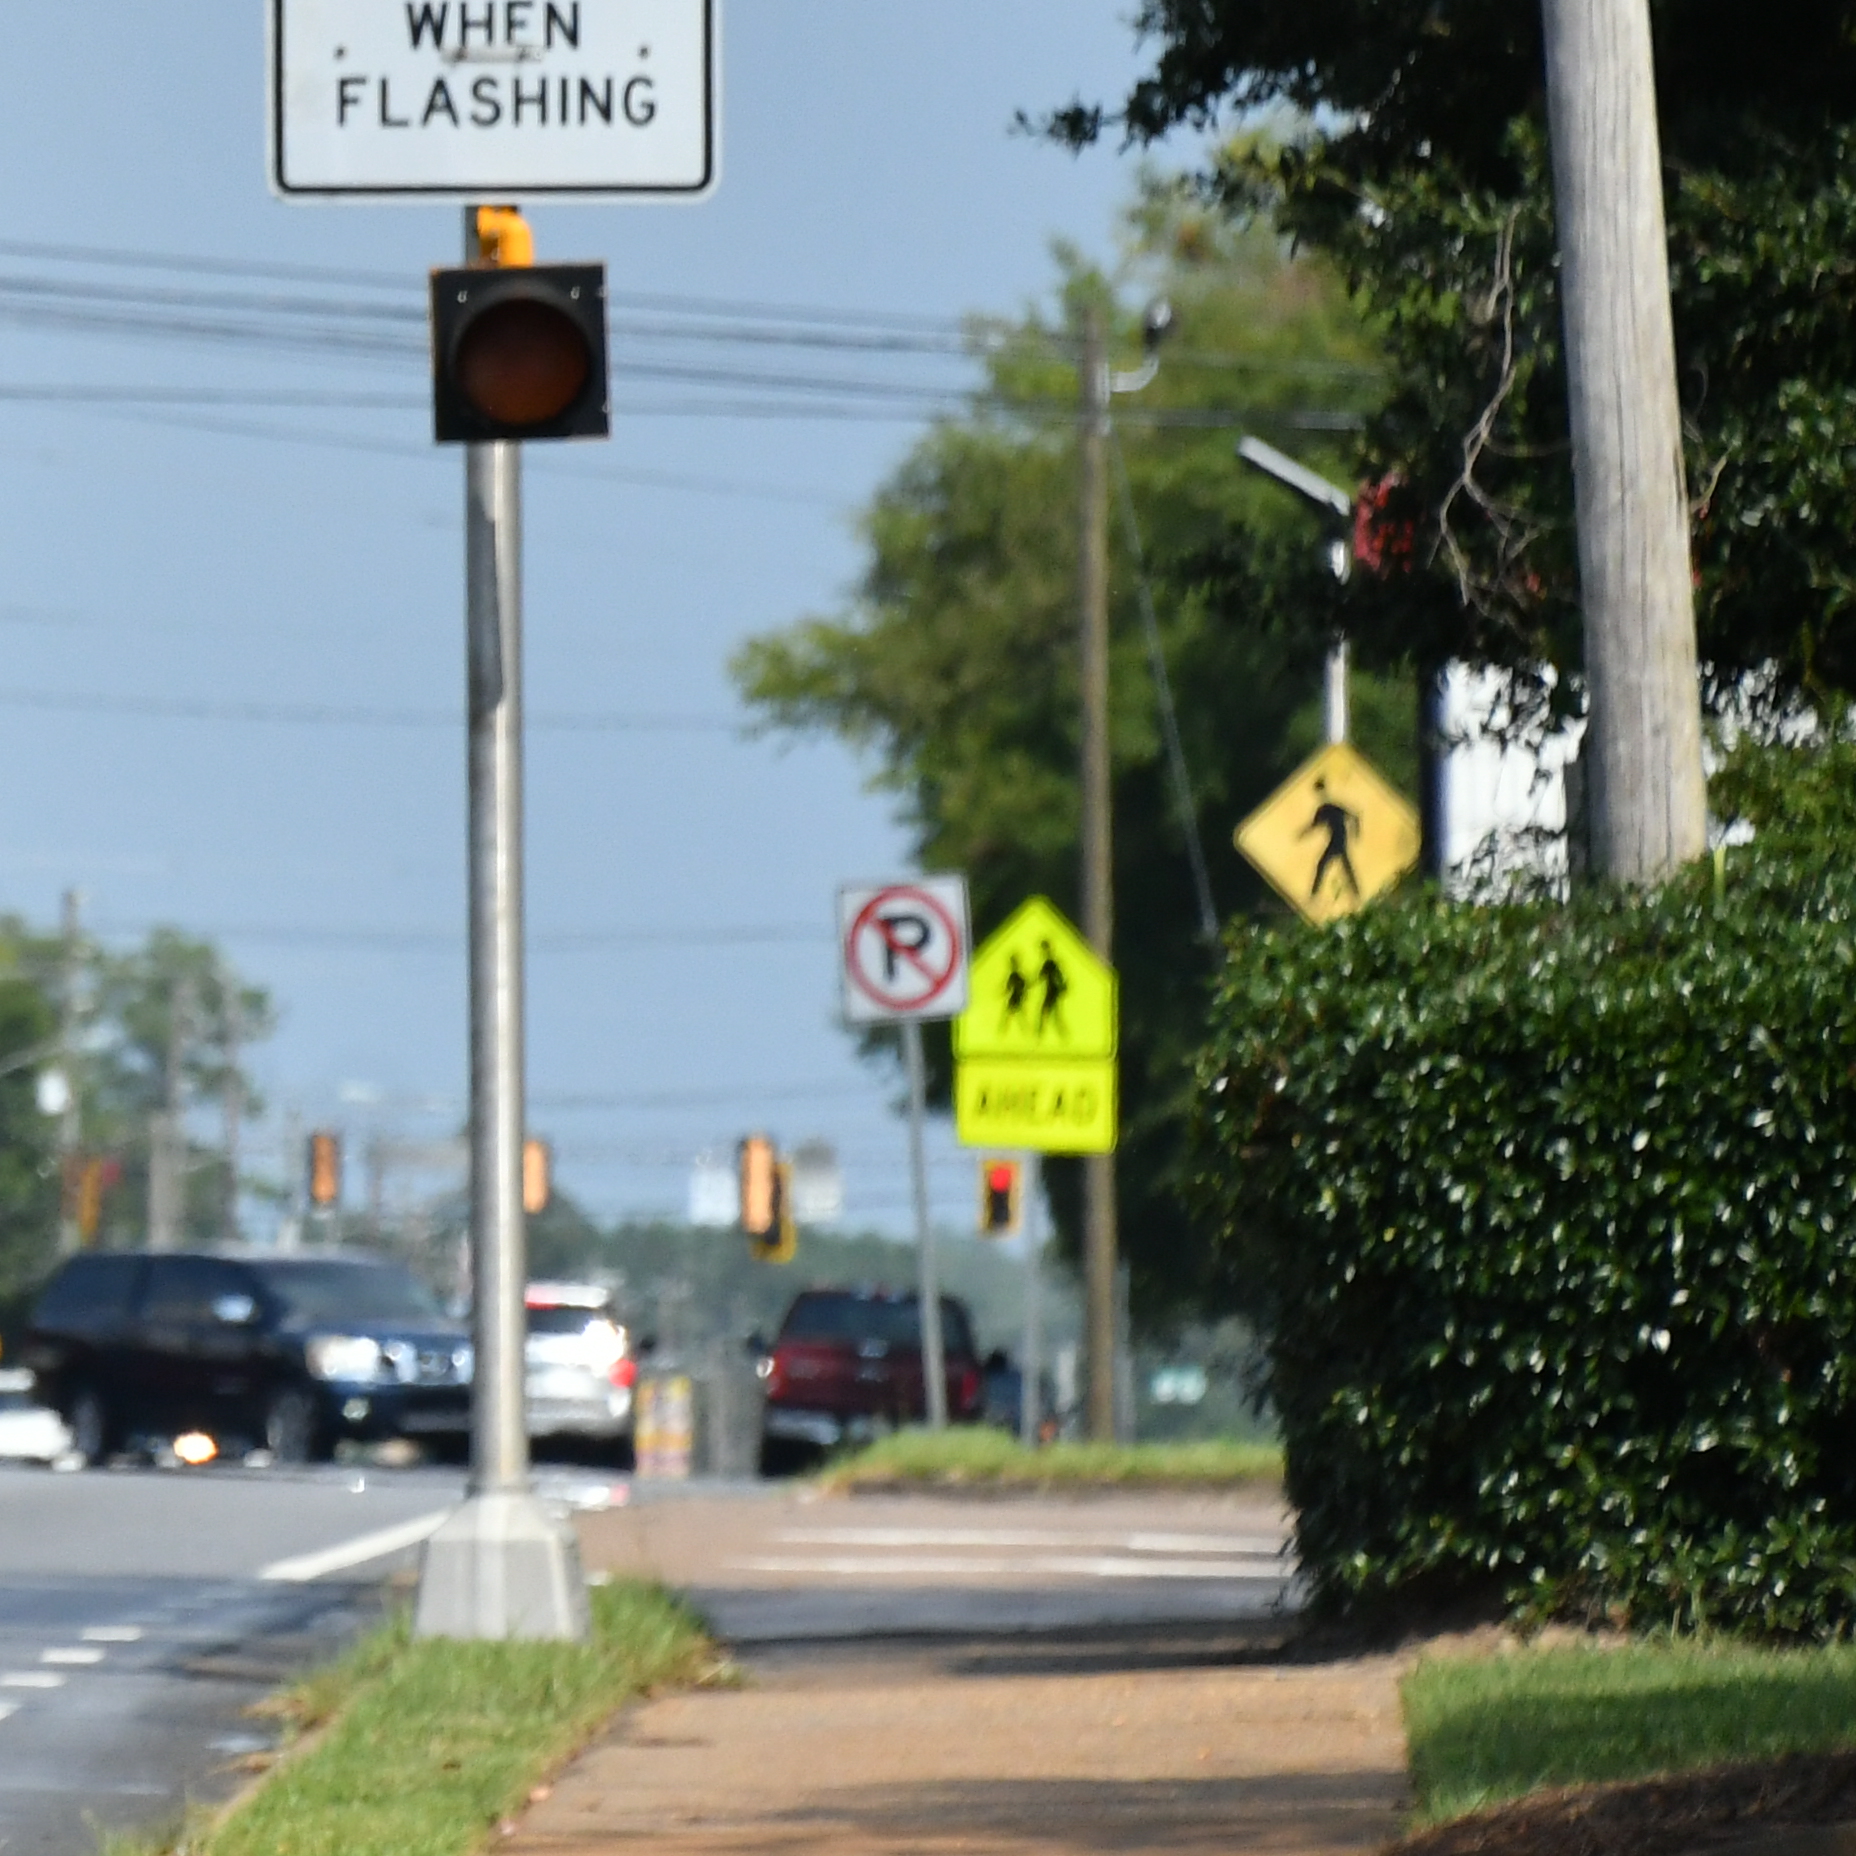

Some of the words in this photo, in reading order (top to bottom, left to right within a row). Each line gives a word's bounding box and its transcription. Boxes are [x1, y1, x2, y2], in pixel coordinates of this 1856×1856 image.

[403, 0, 581, 51] WHEN
[335, 77, 658, 128] FLASHING
[975, 1086, 1100, 1126] AHEAD
